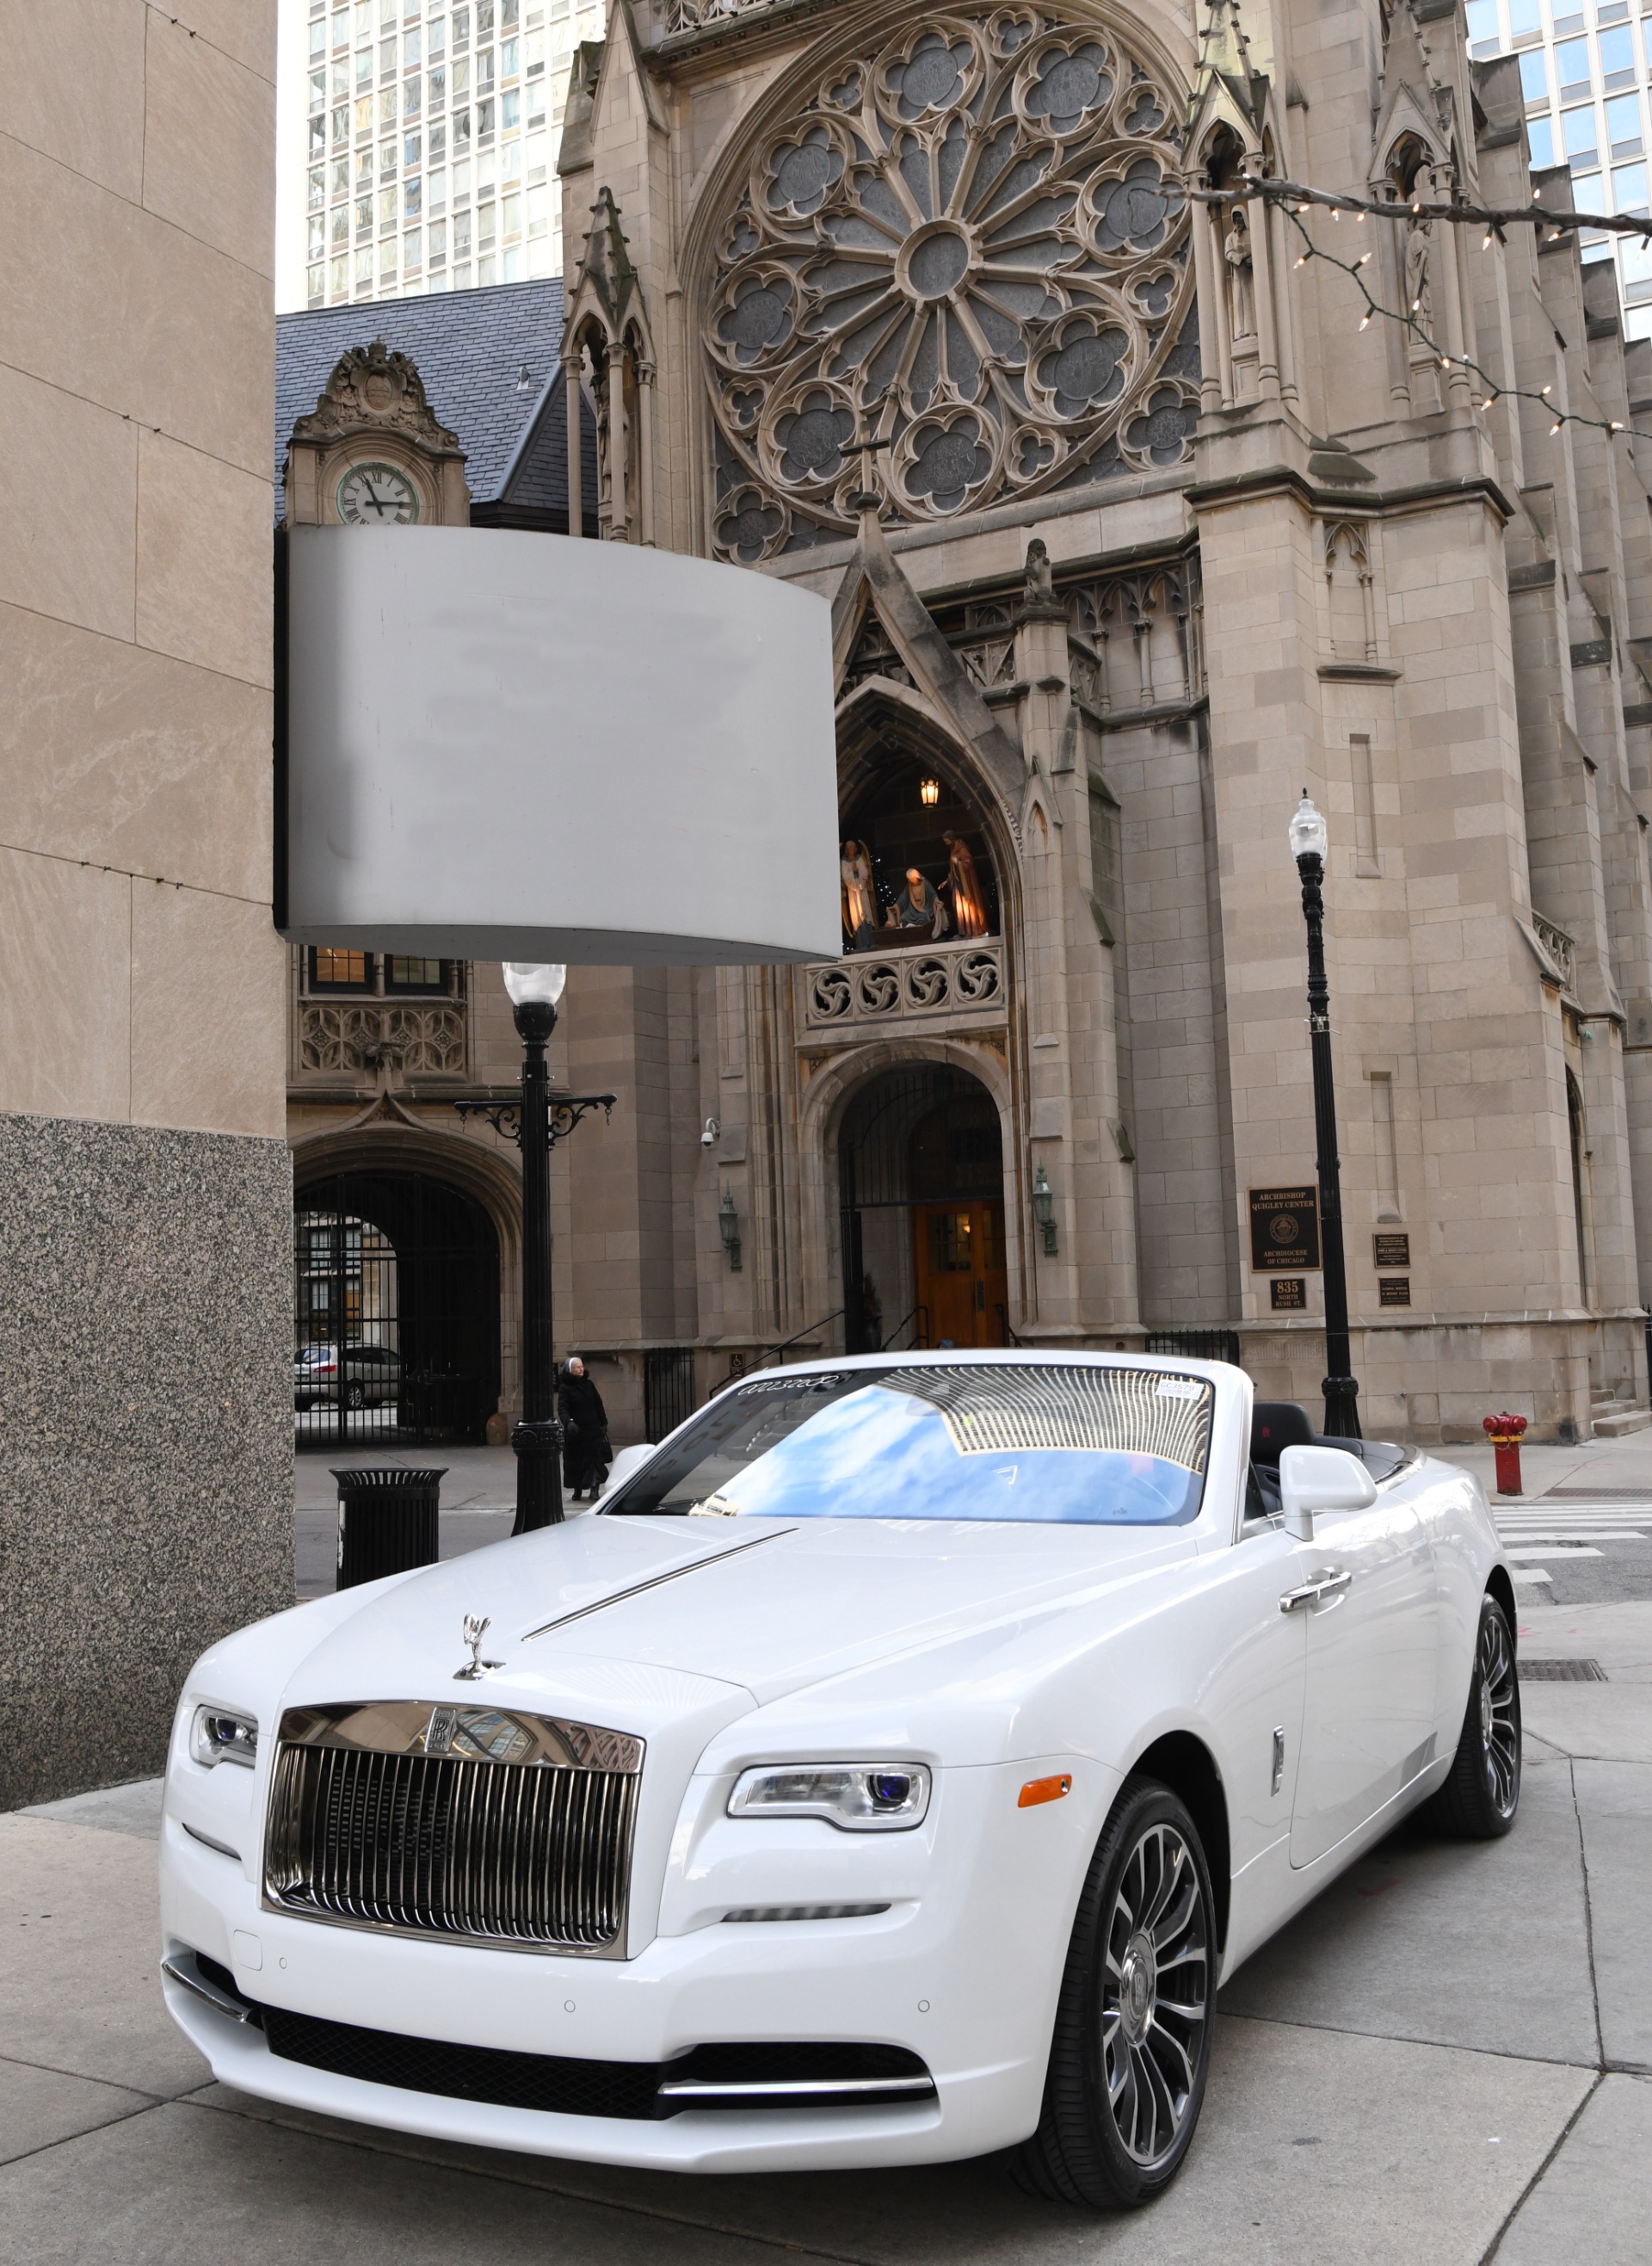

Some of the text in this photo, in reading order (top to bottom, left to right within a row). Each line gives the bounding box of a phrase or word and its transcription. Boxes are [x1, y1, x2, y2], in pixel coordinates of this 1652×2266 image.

[1259, 1191, 1306, 1201] ARCHBISHOP
[1252, 1200, 1315, 1211] QUIGLEY CENTER
[1277, 1281, 1298, 1294] 835
